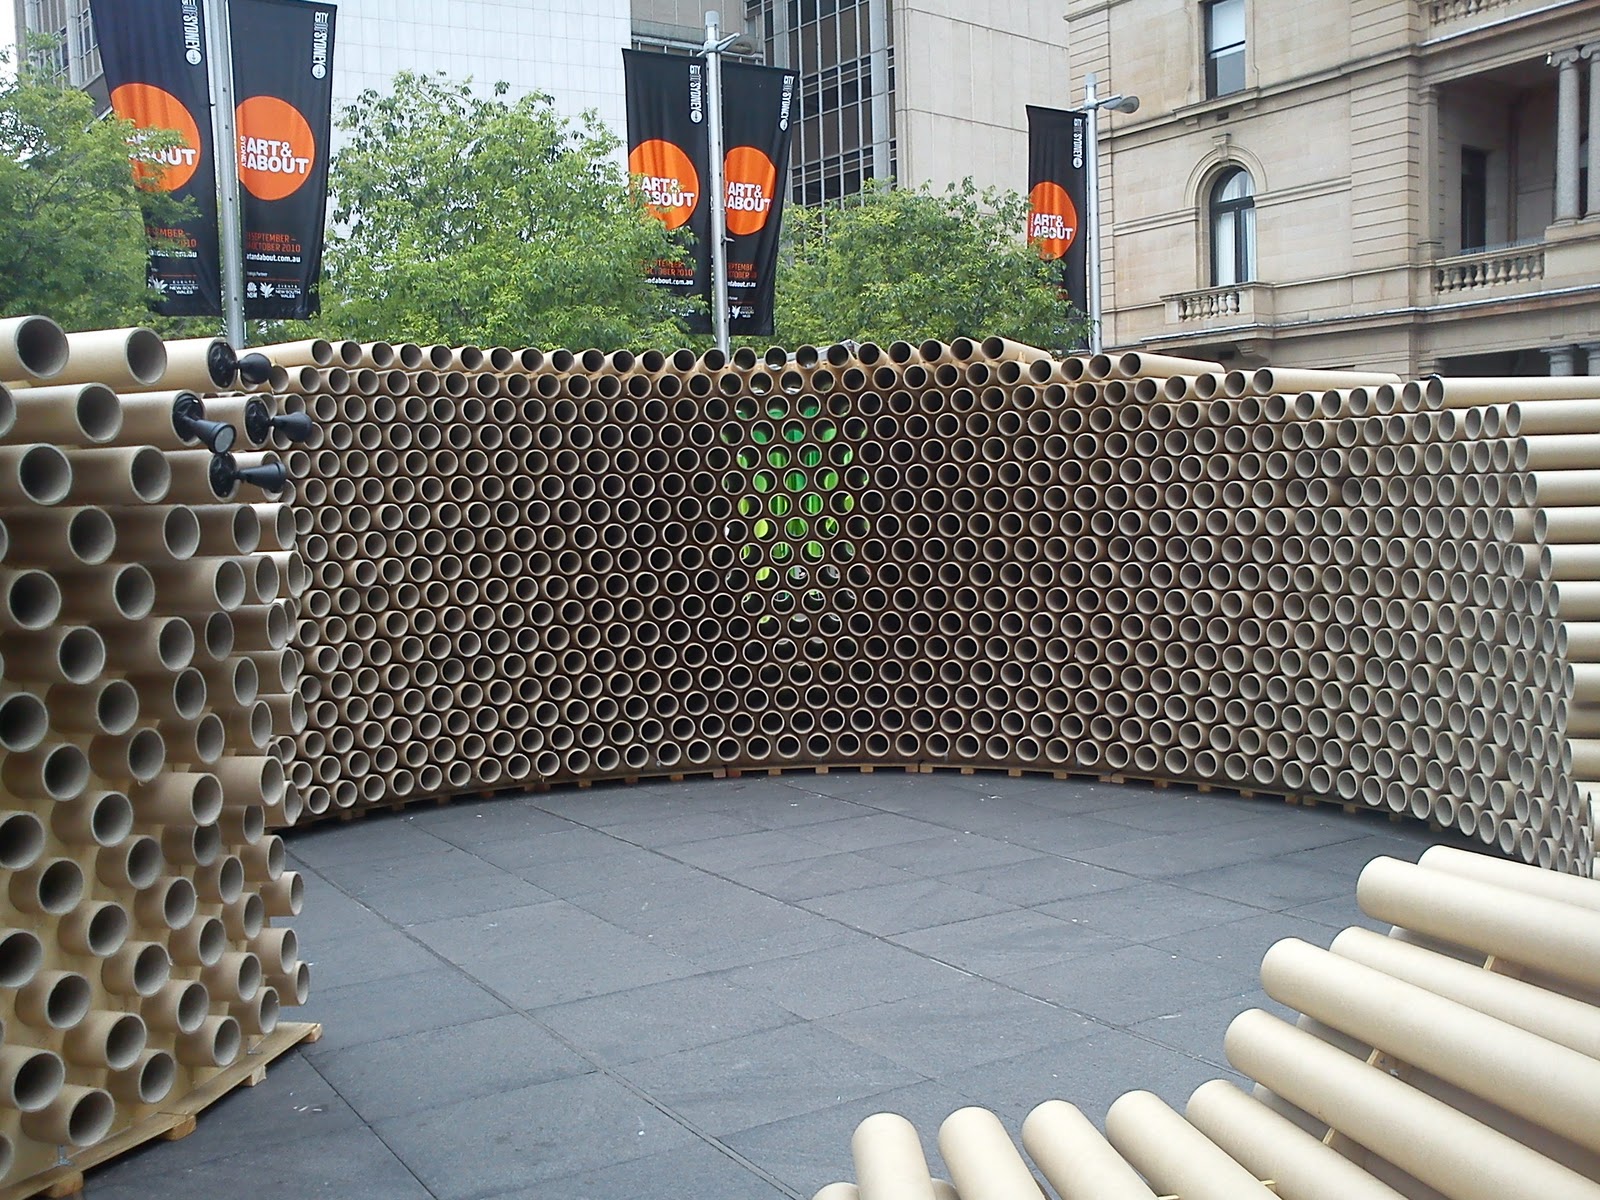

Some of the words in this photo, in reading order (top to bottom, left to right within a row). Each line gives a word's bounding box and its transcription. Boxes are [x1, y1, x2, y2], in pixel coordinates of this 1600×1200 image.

[183, 15, 201, 51] SYDNEY
[313, 32, 328, 66] SYDNEY
[690, 82, 702, 112] SYDNEY
[781, 92, 792, 121] SYDNEY
[246, 137, 293, 158] ART&
[1073, 132, 1083, 159] SYDNEY
[247, 153, 310, 174] ABOUT
[641, 176, 681, 193] ART&
[728, 181, 763, 198] ART&
[727, 195, 771, 212] ABOUT
[1033, 213, 1064, 227] ART&
[1033, 225, 1073, 240] ABOUT
[281, 243, 301, 253] 2010
